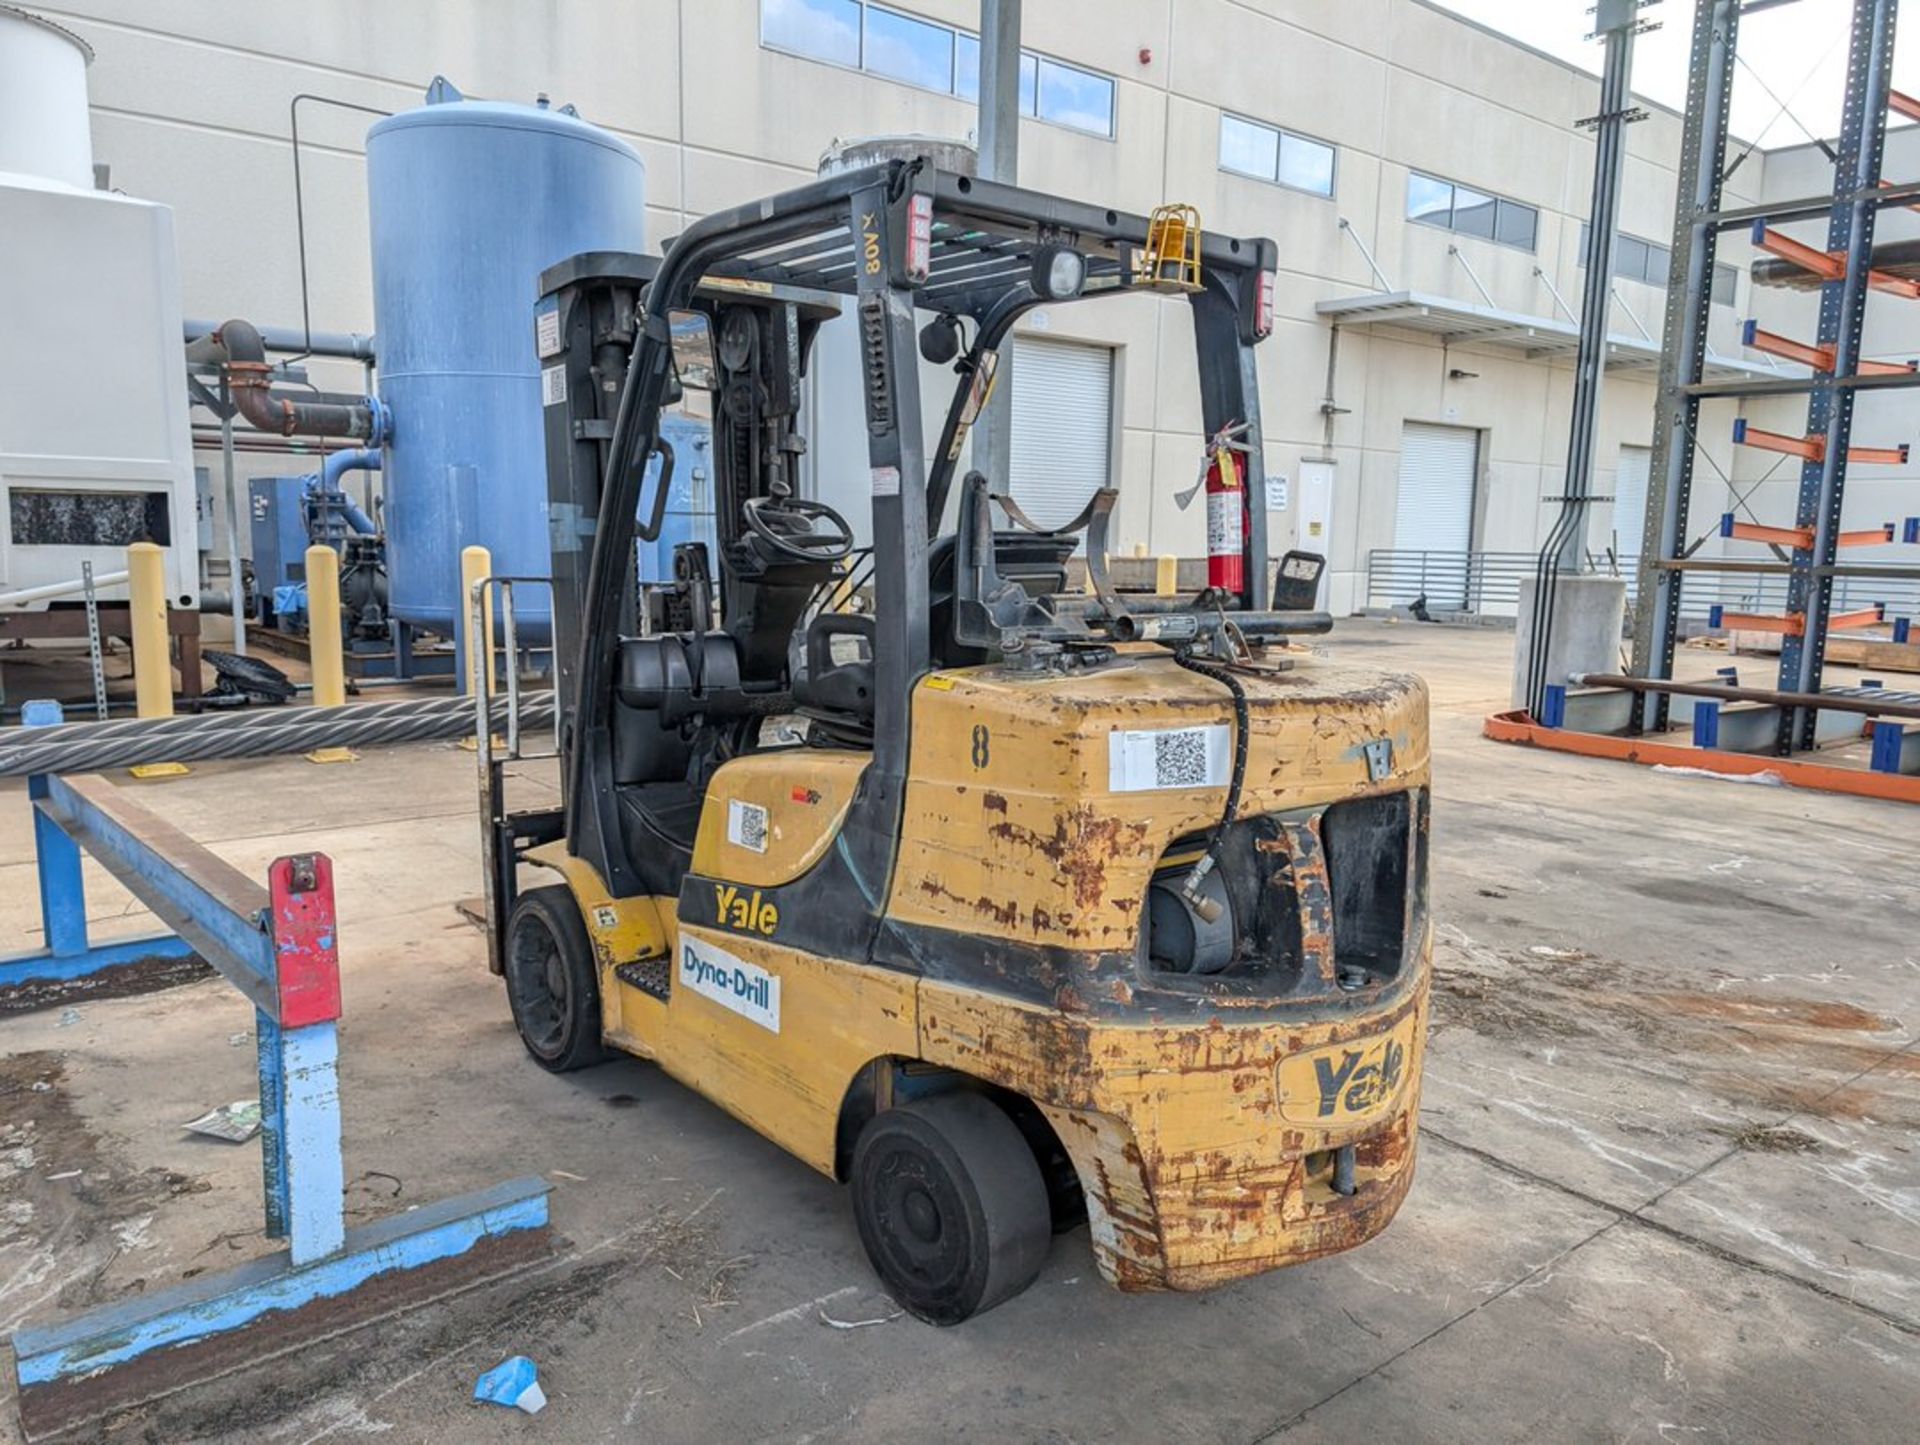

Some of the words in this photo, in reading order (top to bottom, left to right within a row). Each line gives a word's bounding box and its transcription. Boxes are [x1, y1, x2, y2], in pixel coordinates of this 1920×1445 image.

[972, 724, 989, 769] 8
[715, 884, 778, 935] Yale
[684, 945, 769, 1010] Dyna-Drill
[1313, 1037, 1403, 1117] Yale
